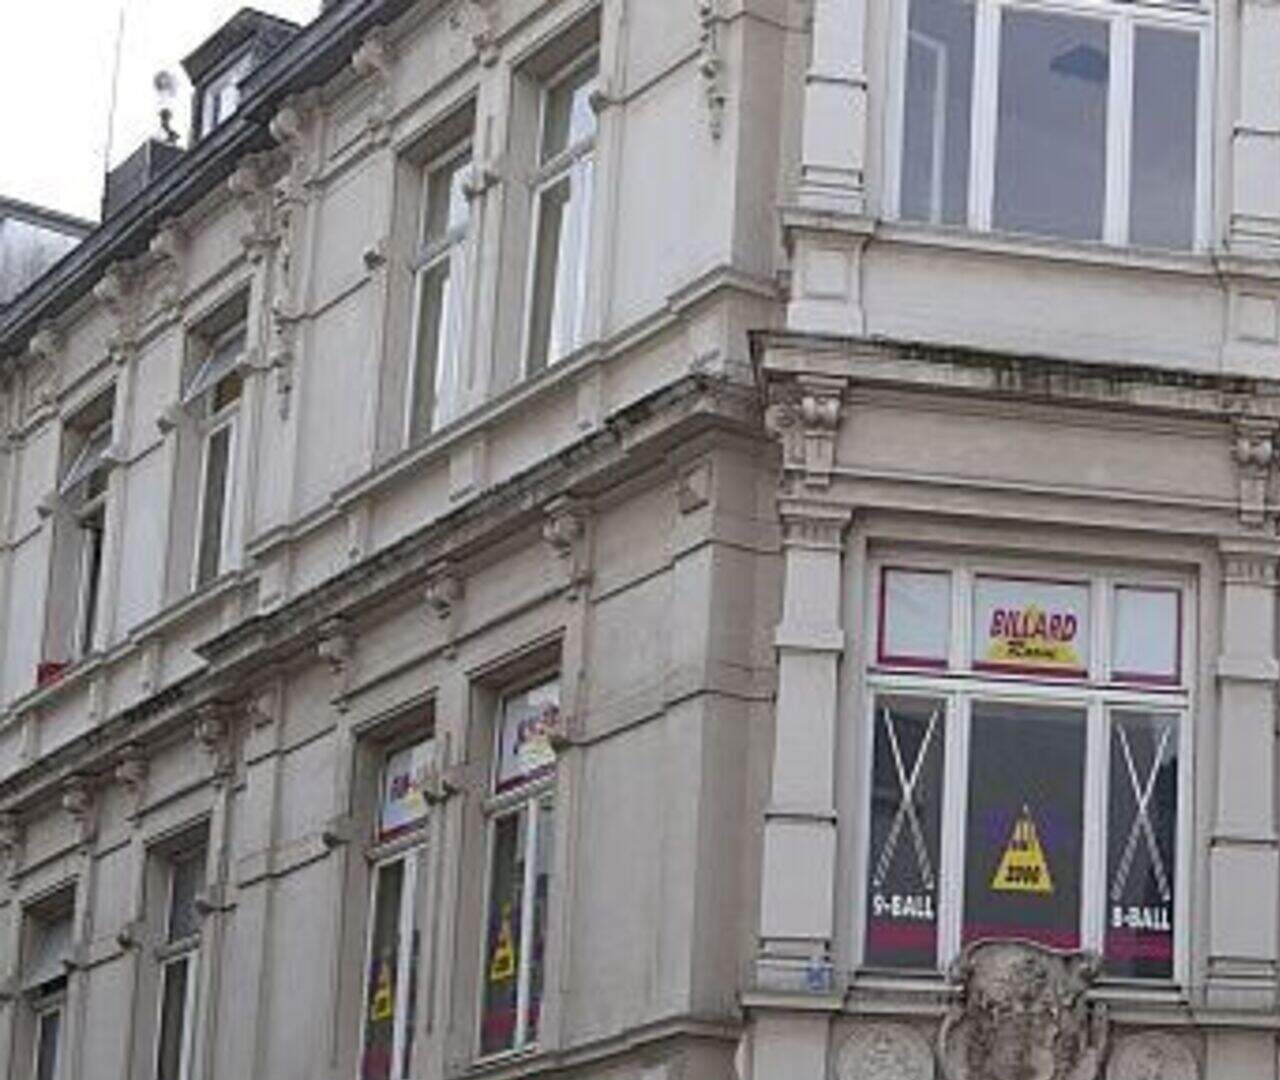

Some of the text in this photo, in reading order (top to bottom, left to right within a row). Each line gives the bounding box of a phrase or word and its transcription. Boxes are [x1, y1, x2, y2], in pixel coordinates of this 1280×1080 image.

[990, 608, 1078, 642] BILLARD
[873, 894, 935, 920] 9-BALL
[1112, 906, 1171, 931] 8-BALL
